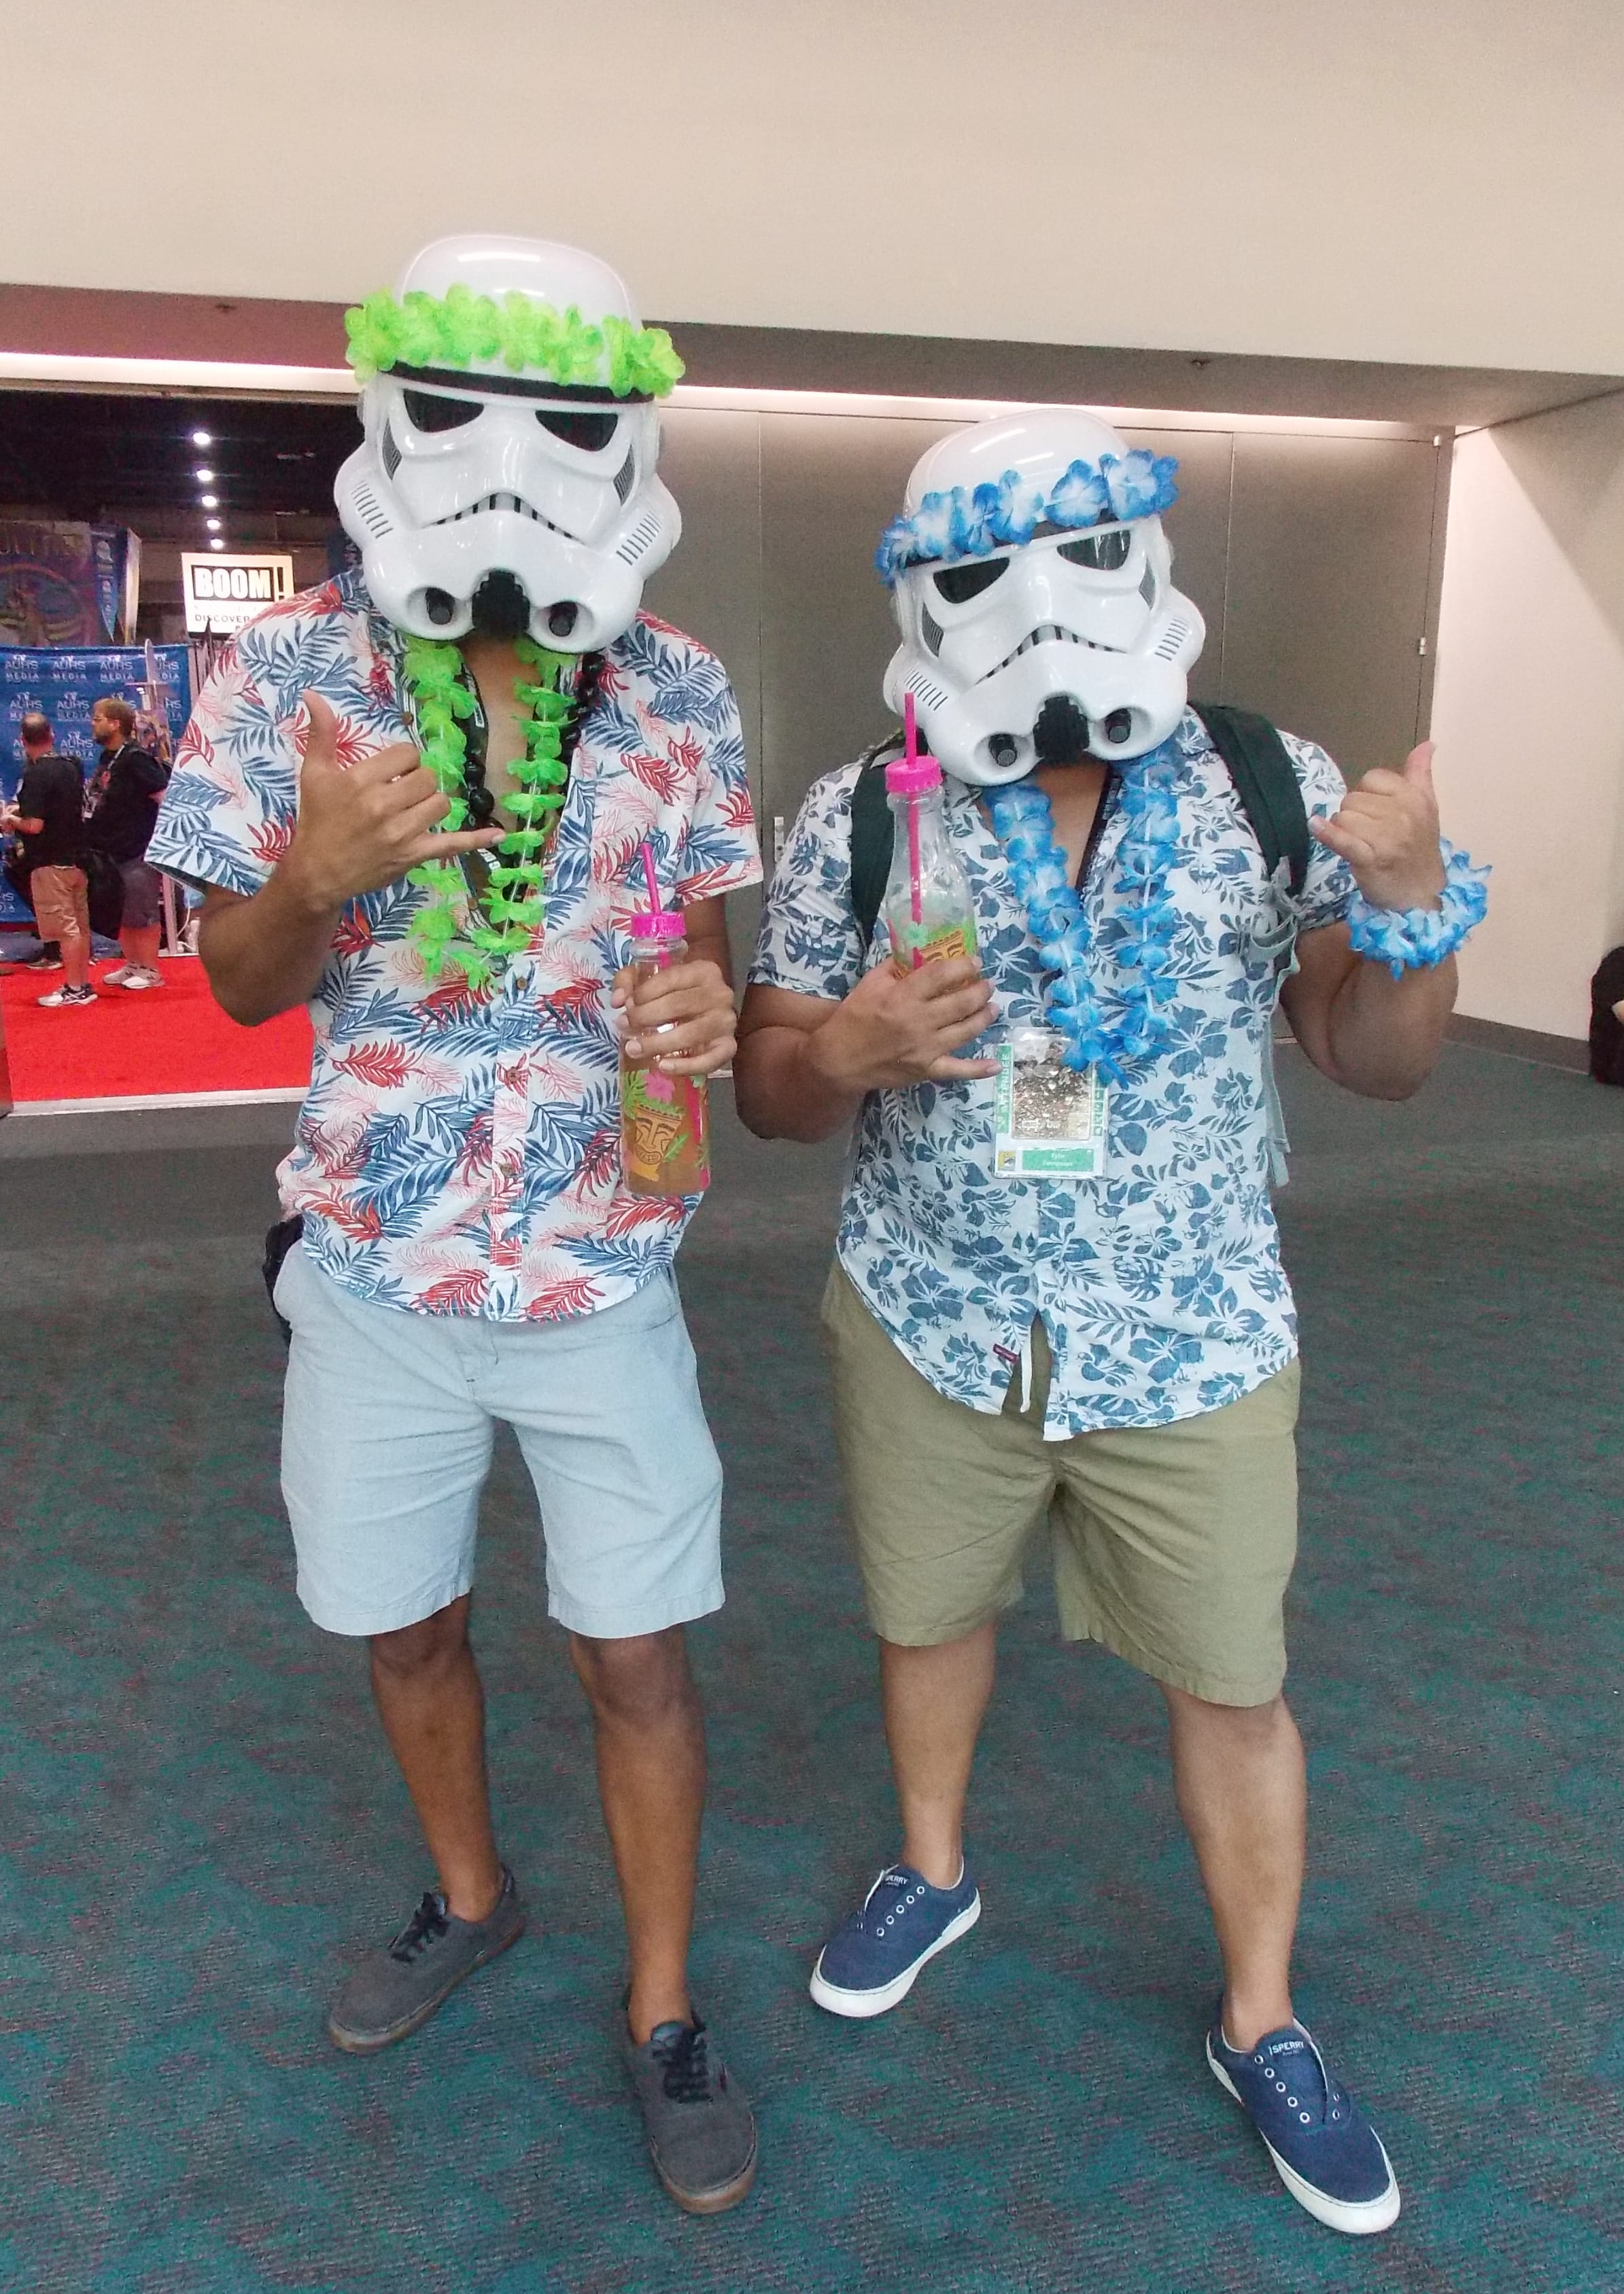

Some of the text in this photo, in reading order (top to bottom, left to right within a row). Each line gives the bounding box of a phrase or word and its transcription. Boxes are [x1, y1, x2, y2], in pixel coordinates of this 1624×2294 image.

[5, 660, 39, 670] AUHS
[52, 661, 86, 670] AUHS
[100, 661, 133, 670] AUHS
[10, 699, 43, 709] AUHS
[56, 699, 90, 710] AUHS
[60, 739, 94, 748] AUHS
